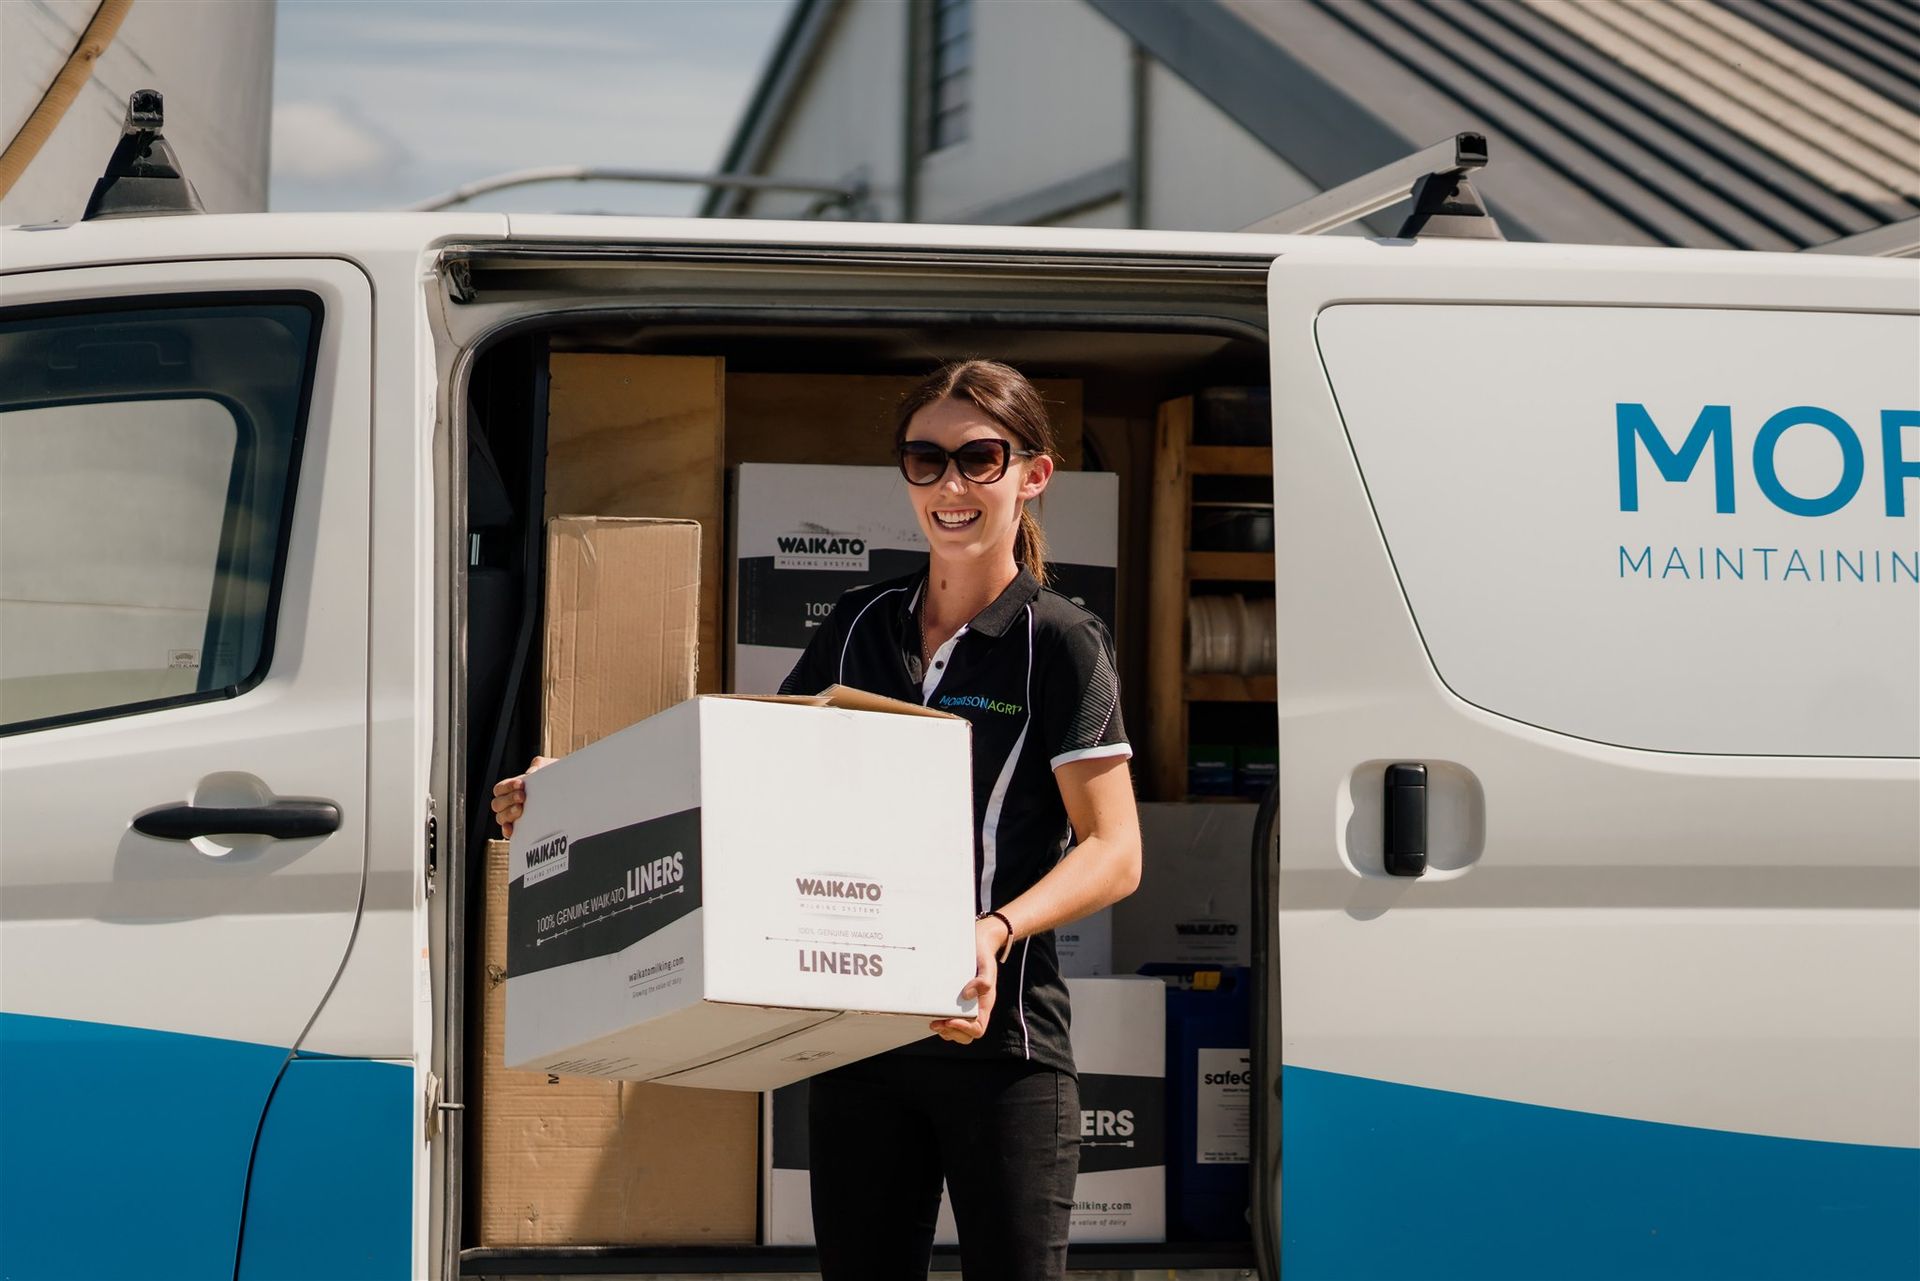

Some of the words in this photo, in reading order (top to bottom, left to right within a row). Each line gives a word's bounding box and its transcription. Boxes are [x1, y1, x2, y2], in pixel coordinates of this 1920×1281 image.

[777, 536, 865, 556] WAIKATO
[805, 602, 837, 617] 100
[526, 835, 568, 869] WAIKATO
[536, 914, 556, 933] 100%
[556, 899, 590, 926] GENUINE
[590, 886, 626, 912] WAIKATO
[626, 851, 685, 899] LINERS
[796, 877, 882, 901] WAIKATO
[851, 930, 884, 940] WAIKATO
[799, 949, 884, 978] LINERS
